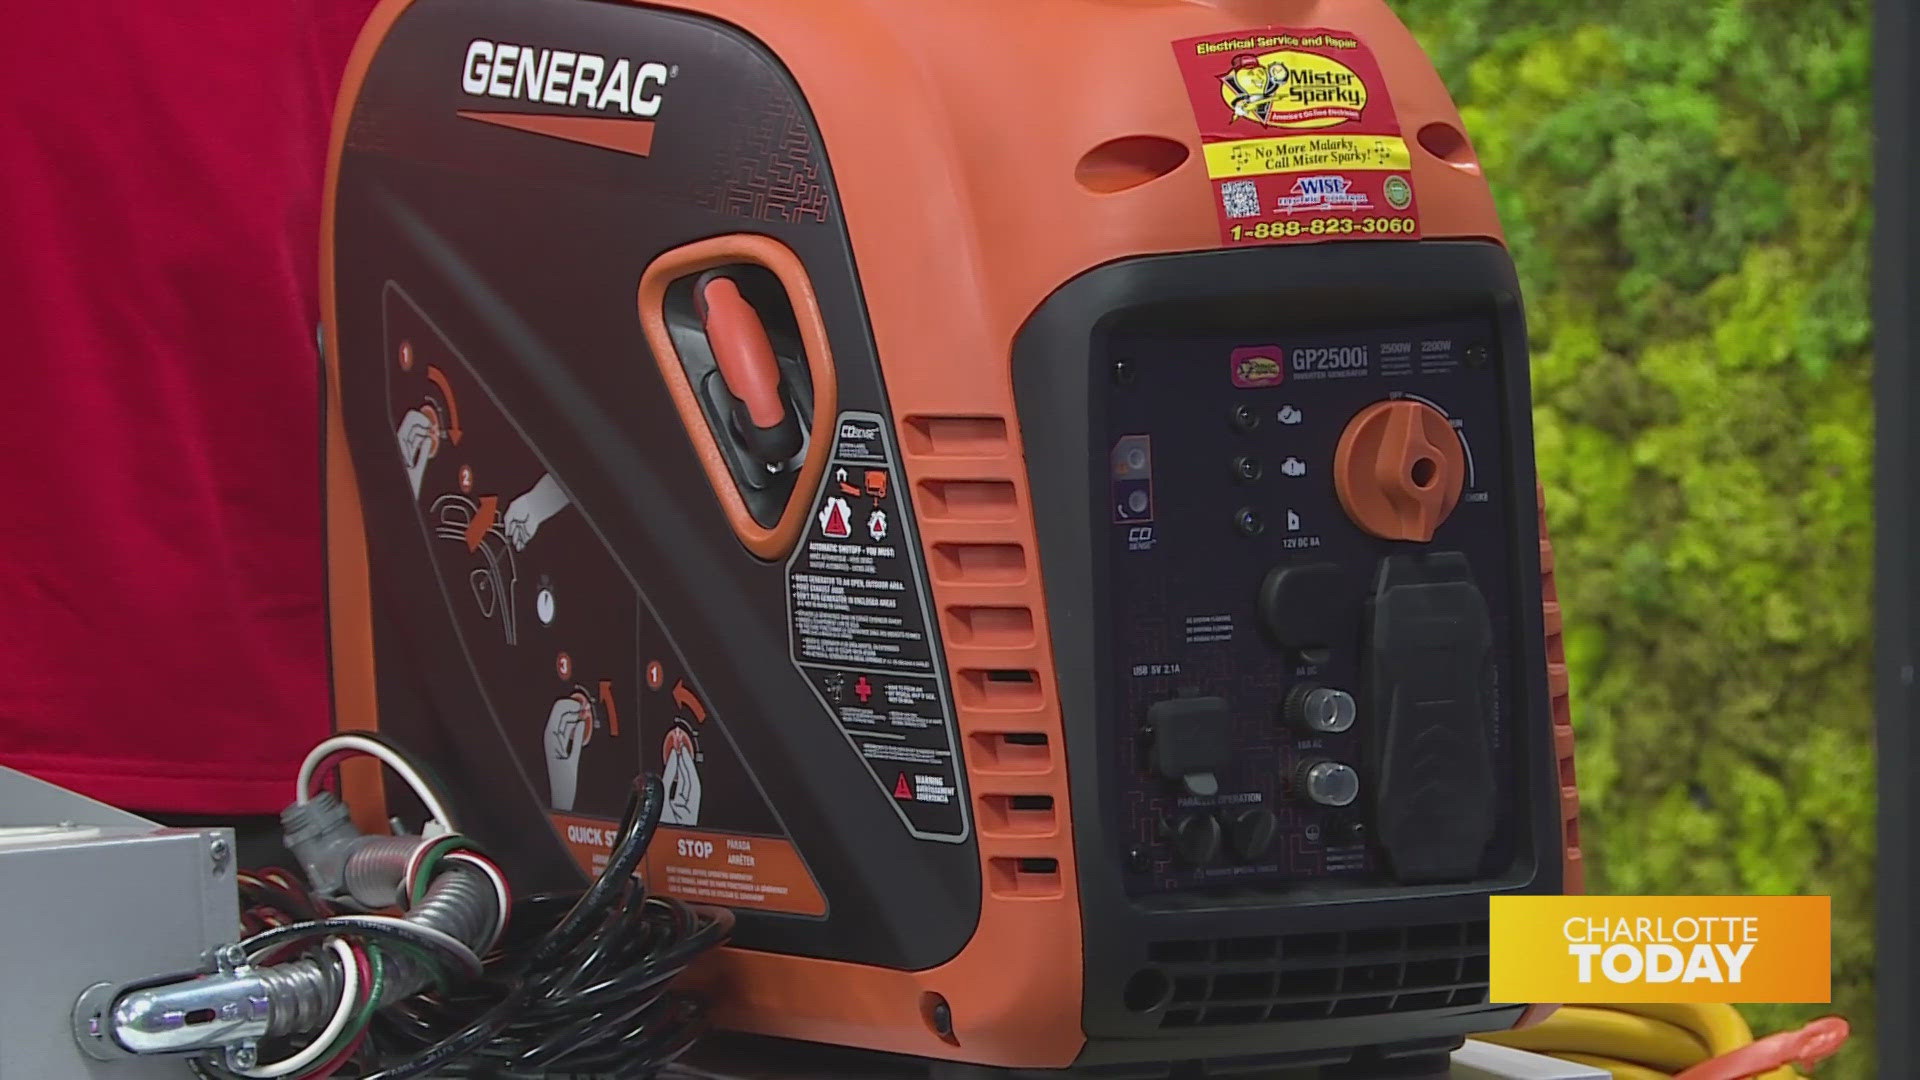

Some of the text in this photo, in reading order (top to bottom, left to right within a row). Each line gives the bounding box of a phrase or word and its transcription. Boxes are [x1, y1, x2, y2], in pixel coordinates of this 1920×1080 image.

[1197, 35, 1358, 55] Electrical Service and Repair
[462, 40, 668, 117] GENERAC
[1290, 69, 1354, 86] Mister
[1290, 86, 1361, 106] Sparky
[1255, 138, 1358, 160] No More Malarky,
[1265, 147, 1371, 170] Call Mister Sparky!
[1230, 216, 1416, 242] 1-888-823-3060
[402, 347, 409, 362] 1
[1292, 346, 1368, 371] GP2500i
[462, 470, 471, 485] 2
[1298, 537, 1309, 548] DC
[560, 658, 568, 672] 3
[651, 667, 658, 681] 1
[567, 825, 603, 846] QUICK
[677, 839, 751, 859] STOP PARADA
